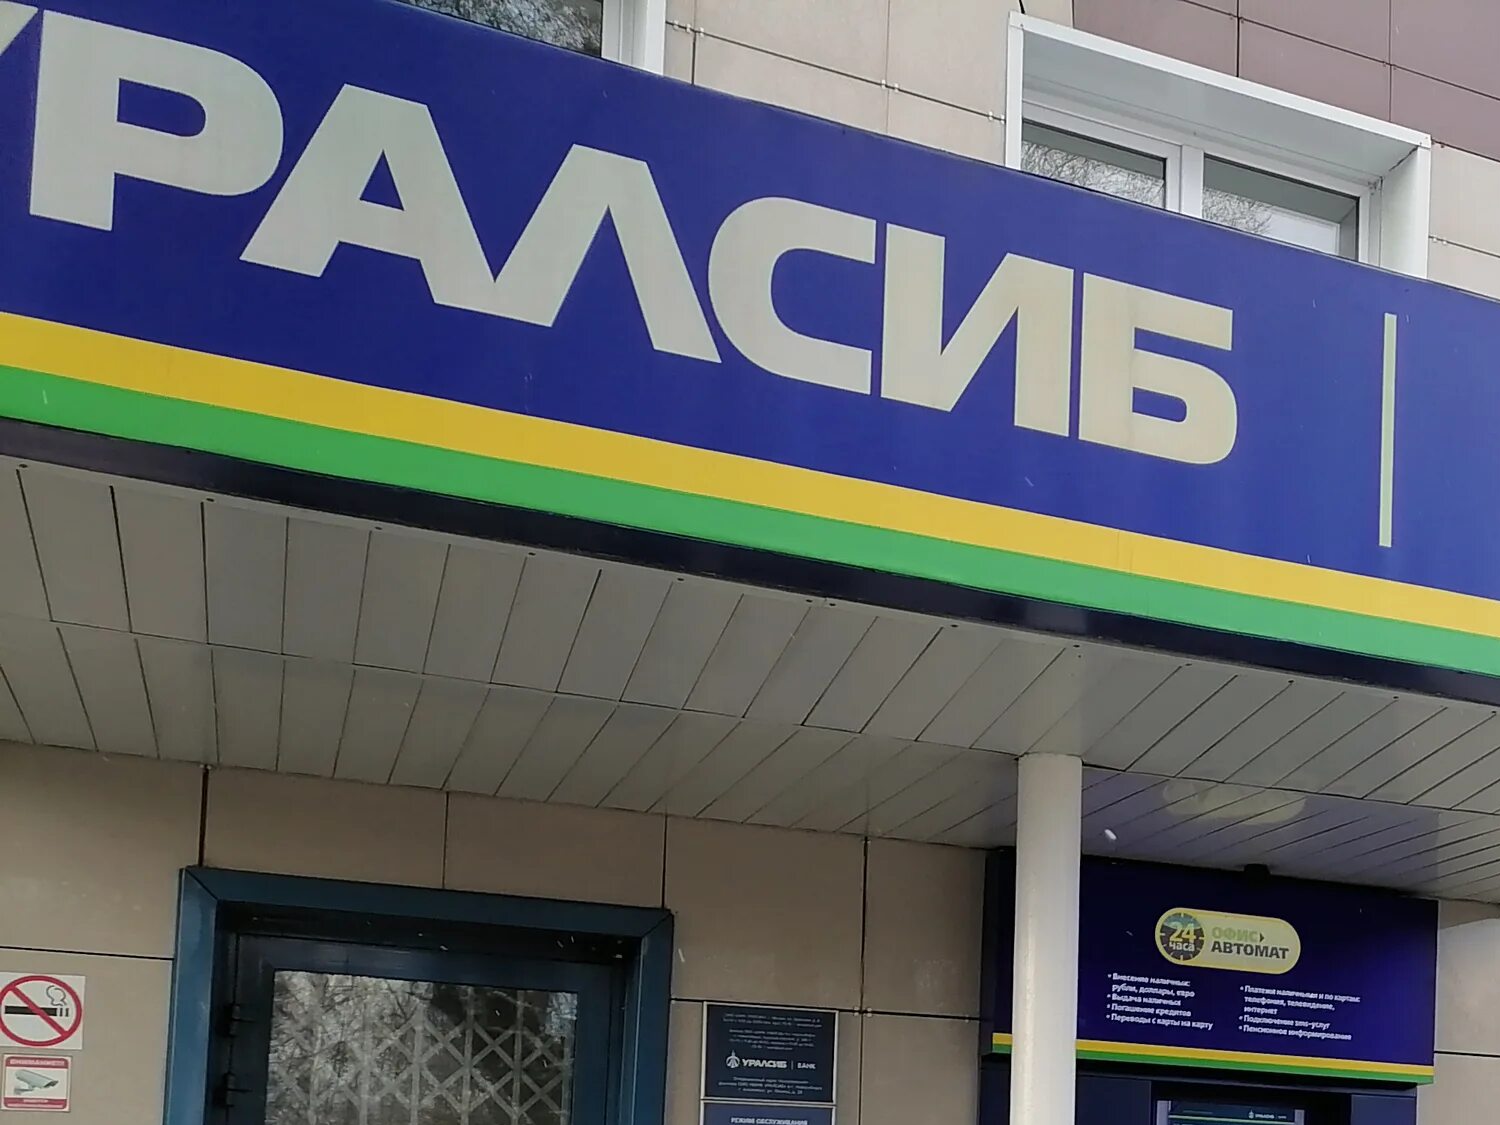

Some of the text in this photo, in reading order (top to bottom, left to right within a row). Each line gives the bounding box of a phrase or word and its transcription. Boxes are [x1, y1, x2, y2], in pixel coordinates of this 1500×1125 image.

[0, 0, 1238, 465] РАЛСИБ
[1169, 921, 1197, 942] 24
[1211, 927, 1259, 943] ОФИС
[1169, 940, 1195, 952] часа
[1211, 941, 1289, 959] АВТОМАТ
